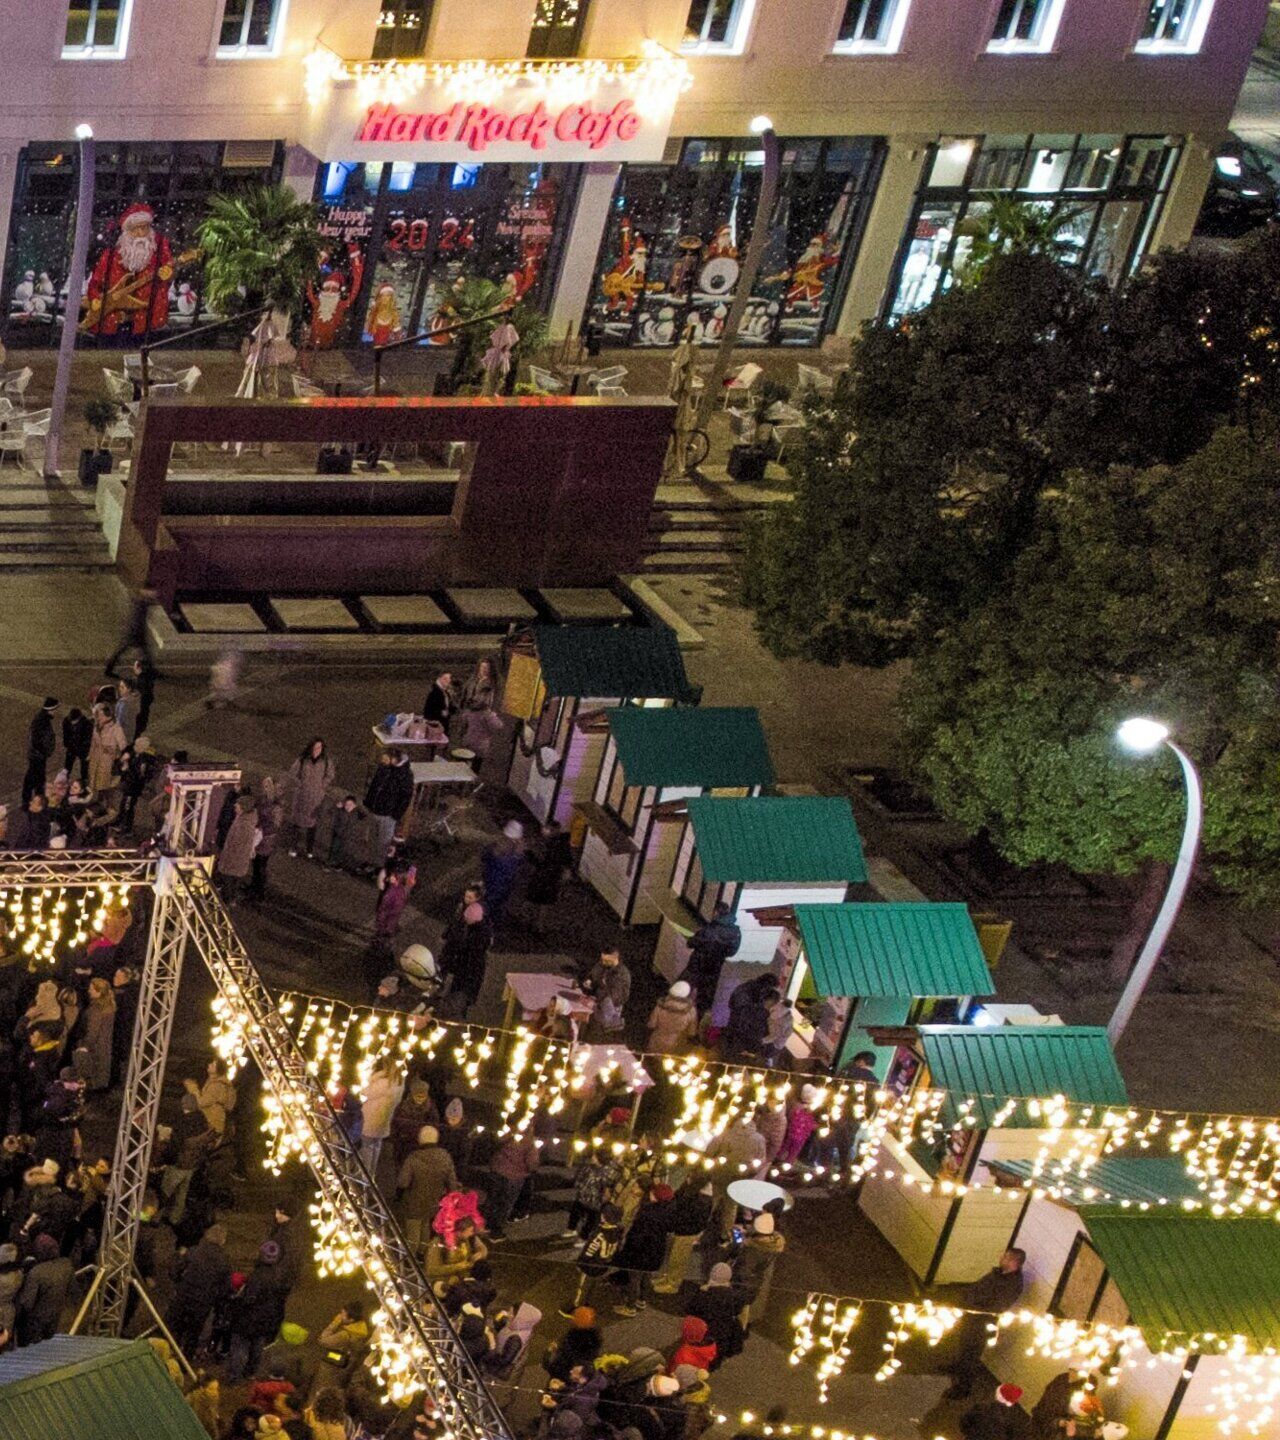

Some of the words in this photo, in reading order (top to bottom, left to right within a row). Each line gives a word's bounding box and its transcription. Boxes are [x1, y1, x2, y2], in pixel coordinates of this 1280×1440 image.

[356, 100, 465, 142] Hard
[456, 100, 552, 151] Rock
[554, 98, 639, 149] Cafe
[327, 206, 367, 226] Happy
[316, 222, 342, 238] New
[389, 218, 429, 250] 20
[440, 217, 475, 250] 24
